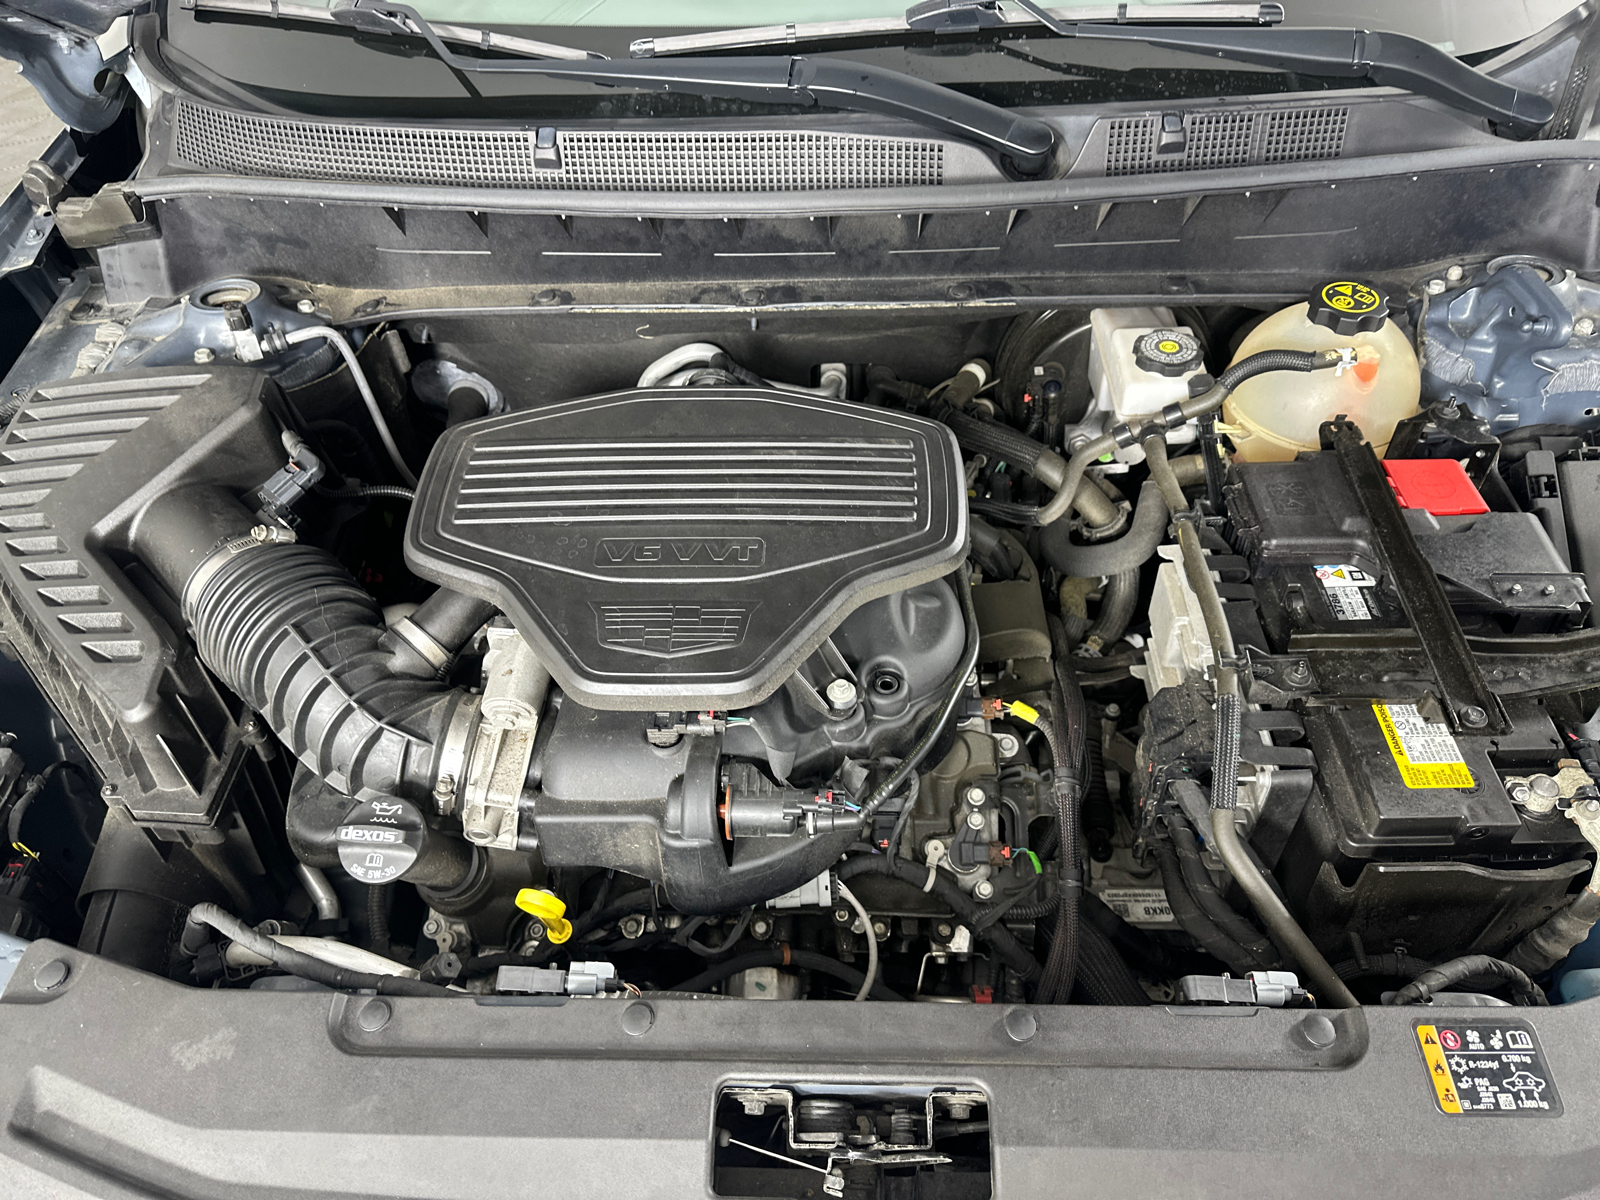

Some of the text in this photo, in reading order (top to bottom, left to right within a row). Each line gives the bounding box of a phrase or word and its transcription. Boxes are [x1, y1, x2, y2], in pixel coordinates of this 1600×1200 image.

[603, 542, 758, 562] V6 VVT
[1330, 593, 1345, 616] 3786
[1376, 703, 1401, 750] DANGER POISO
[340, 825, 397, 841] dexos
[350, 863, 365, 876] SAE
[1468, 1060, 1500, 1069] R-1234yf
[1501, 1054, 1532, 1064] 0.700 kg
[1474, 1077, 1490, 1086] PAG
[1517, 1099, 1549, 1110] 1.000 kg
